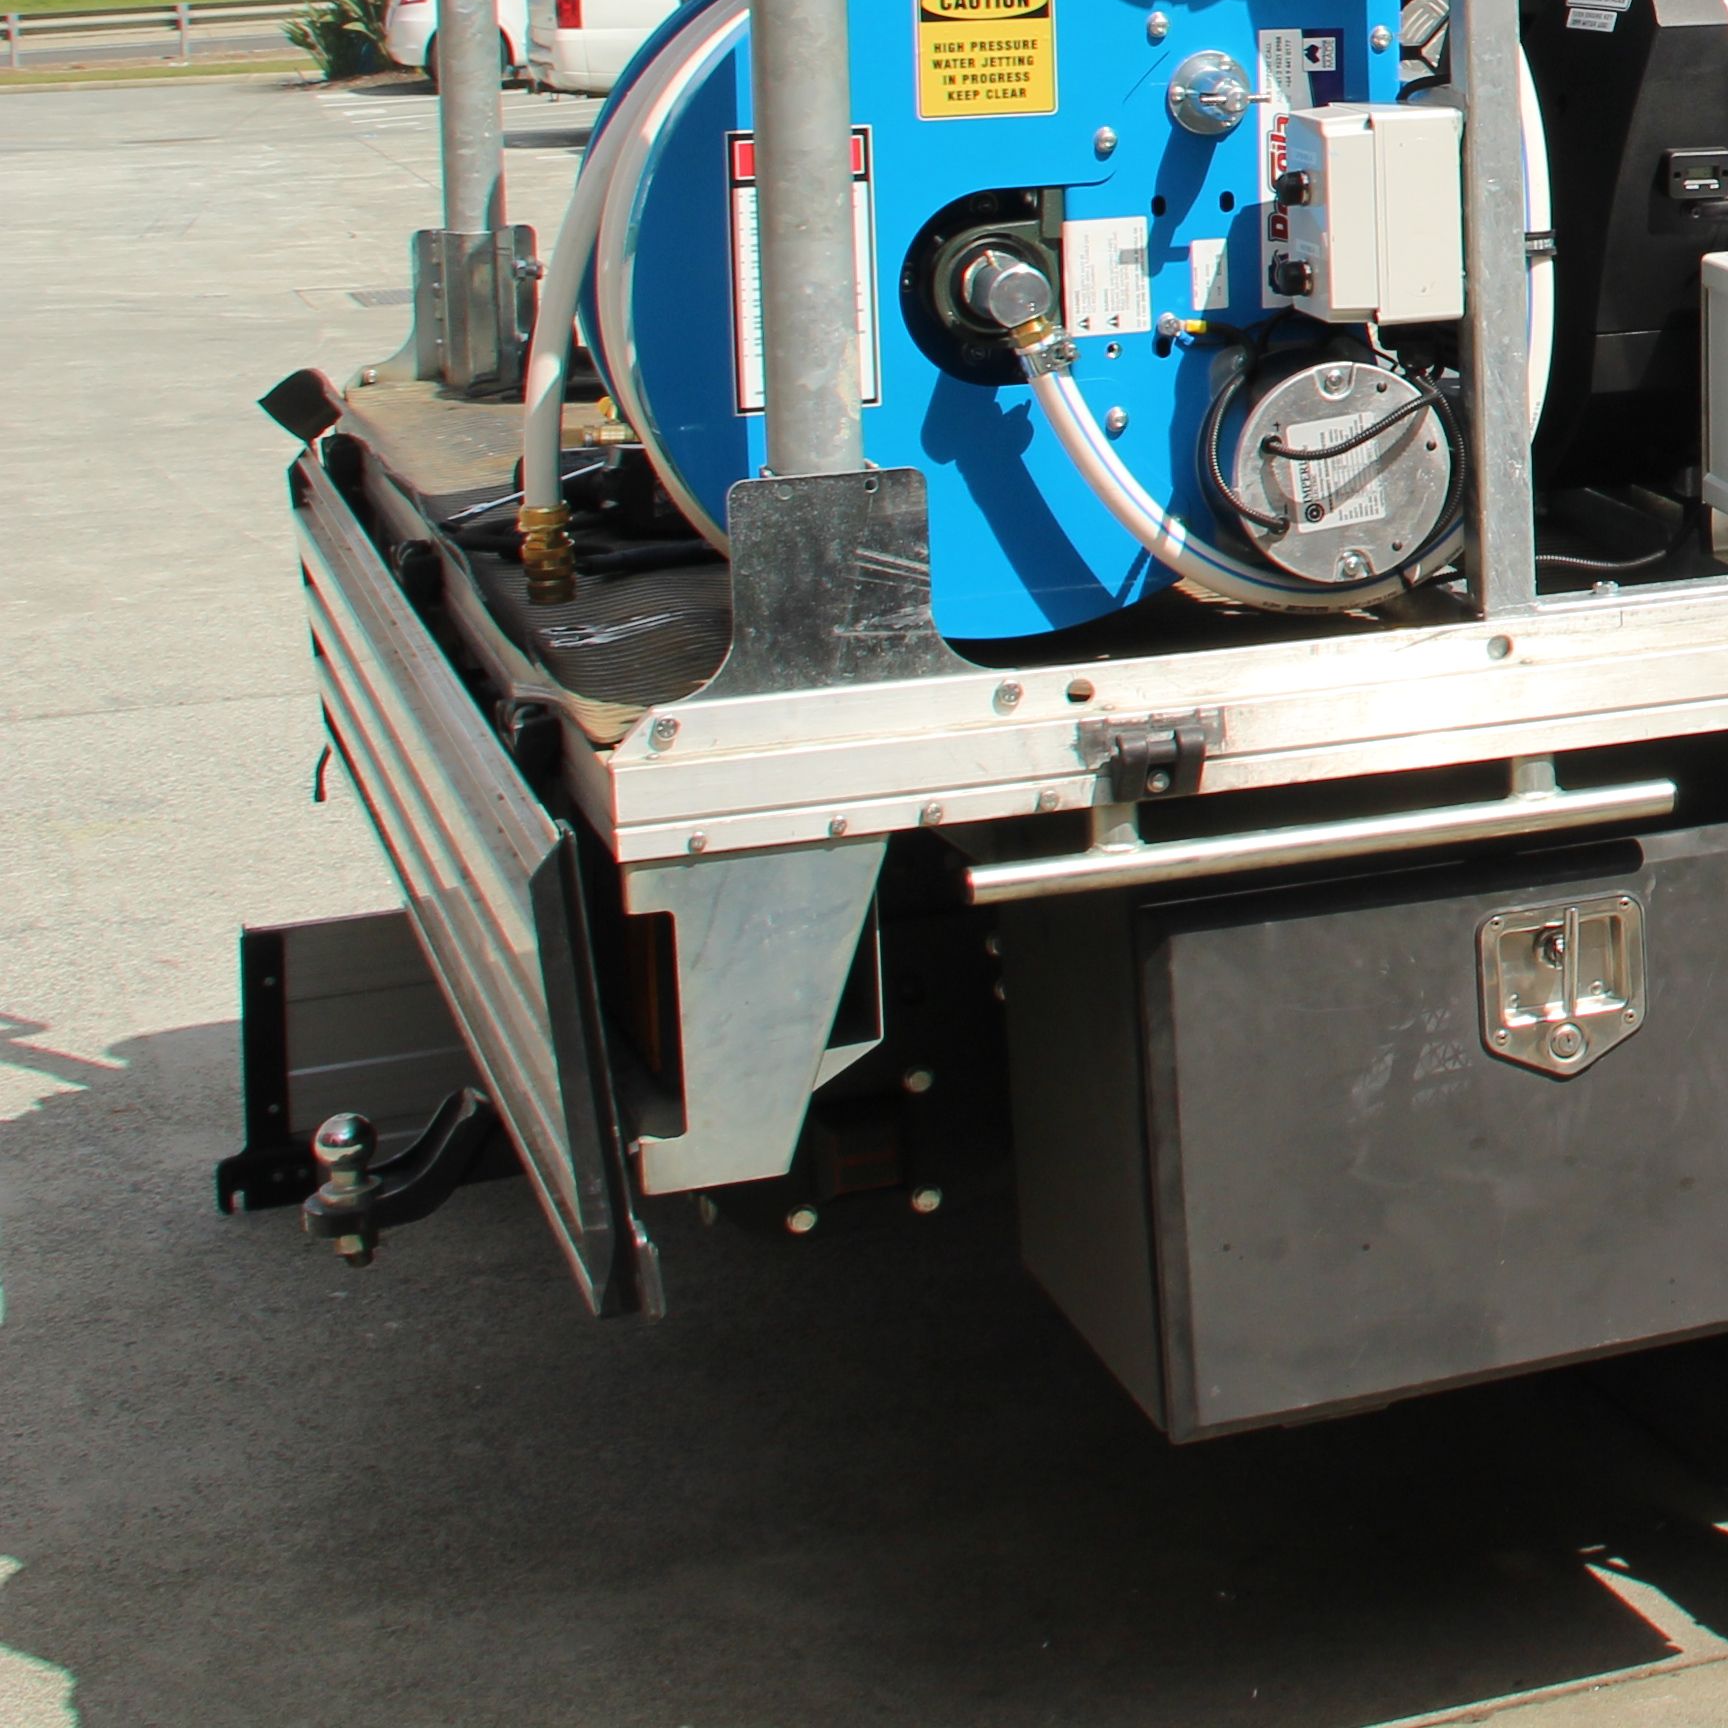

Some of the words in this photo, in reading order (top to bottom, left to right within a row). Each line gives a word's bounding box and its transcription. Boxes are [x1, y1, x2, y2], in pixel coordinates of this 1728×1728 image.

[933, 42, 965, 53] HIGH
[970, 39, 1039, 52] PRESSURE
[932, 58, 976, 70] WATER
[981, 55, 1035, 68] JETTING
[942, 75, 957, 85] IN
[962, 72, 1031, 84] PROGRESS
[947, 90, 980, 101] KEEP
[985, 88, 1028, 100] CLEAR
